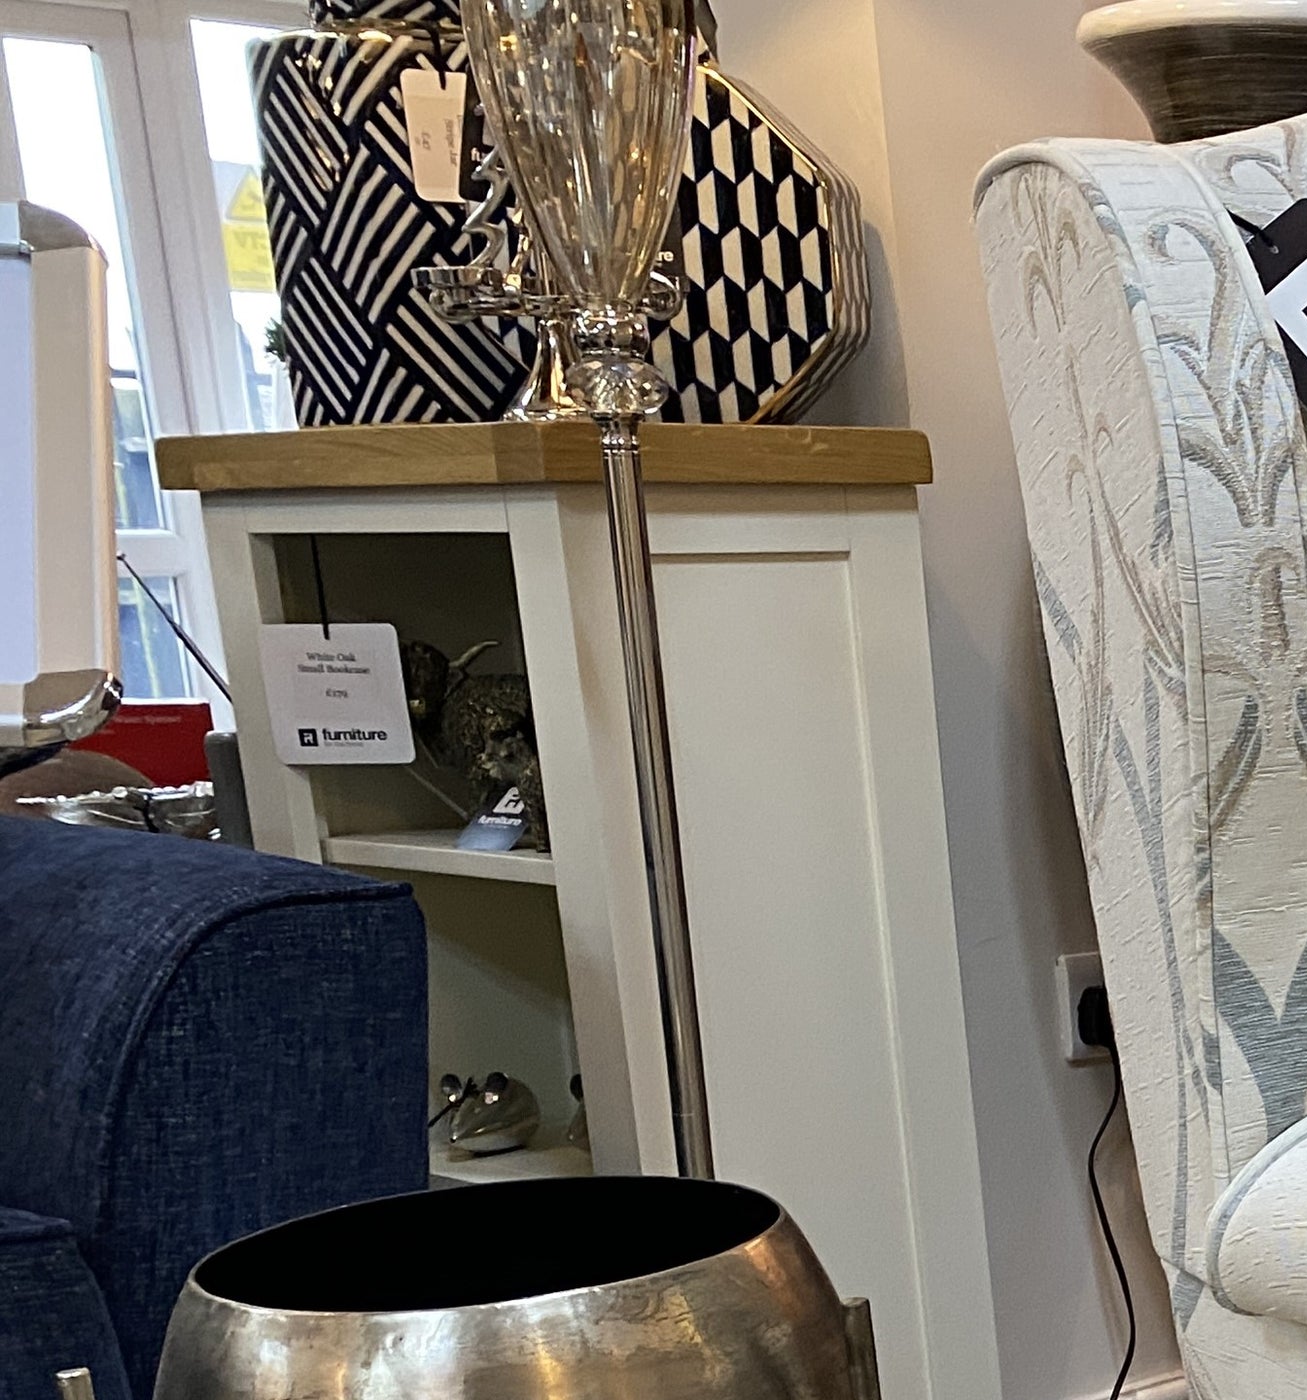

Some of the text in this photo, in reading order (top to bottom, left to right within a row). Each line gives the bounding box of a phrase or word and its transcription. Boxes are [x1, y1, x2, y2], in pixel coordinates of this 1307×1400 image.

[337, 652, 356, 661] Oak
[326, 664, 370, 674] Bookcase
[322, 728, 387, 740] furniture
